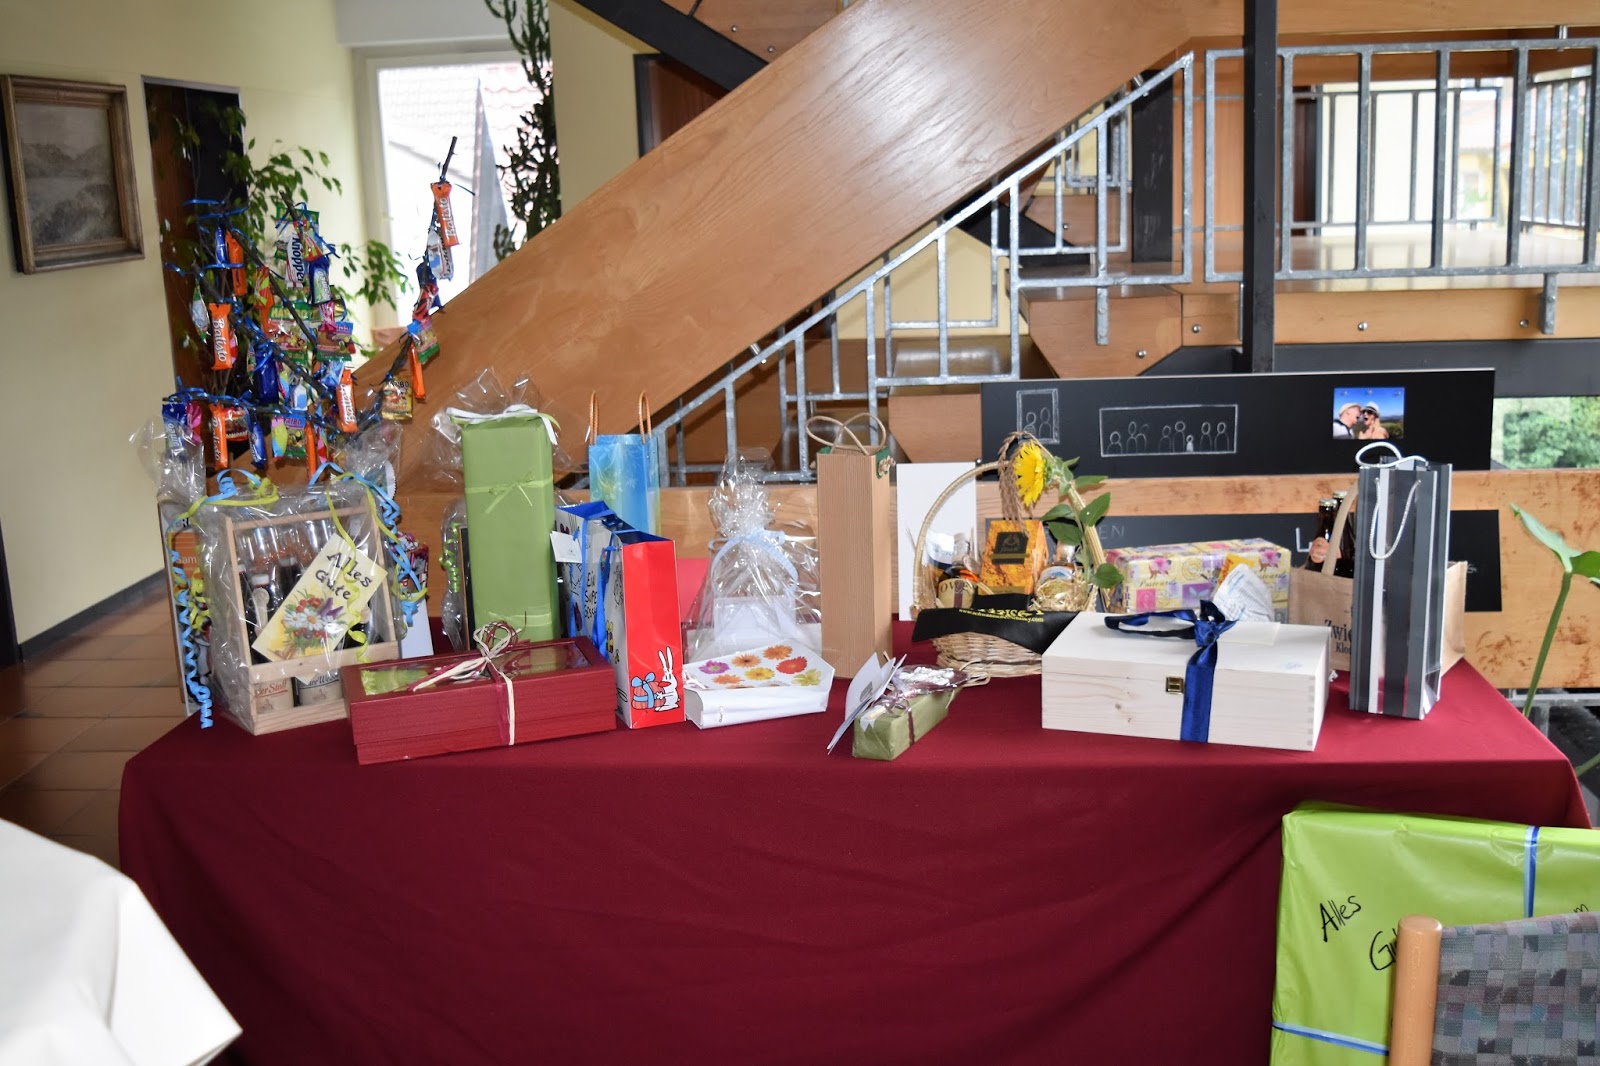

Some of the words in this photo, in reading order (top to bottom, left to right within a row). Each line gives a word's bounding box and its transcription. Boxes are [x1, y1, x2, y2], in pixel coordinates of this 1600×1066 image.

[439, 197, 456, 237] Balisto
[212, 317, 227, 362] Balisto
[315, 568, 352, 600] Gute
[326, 551, 372, 588] Alles
[1318, 894, 1362, 943] Alles
